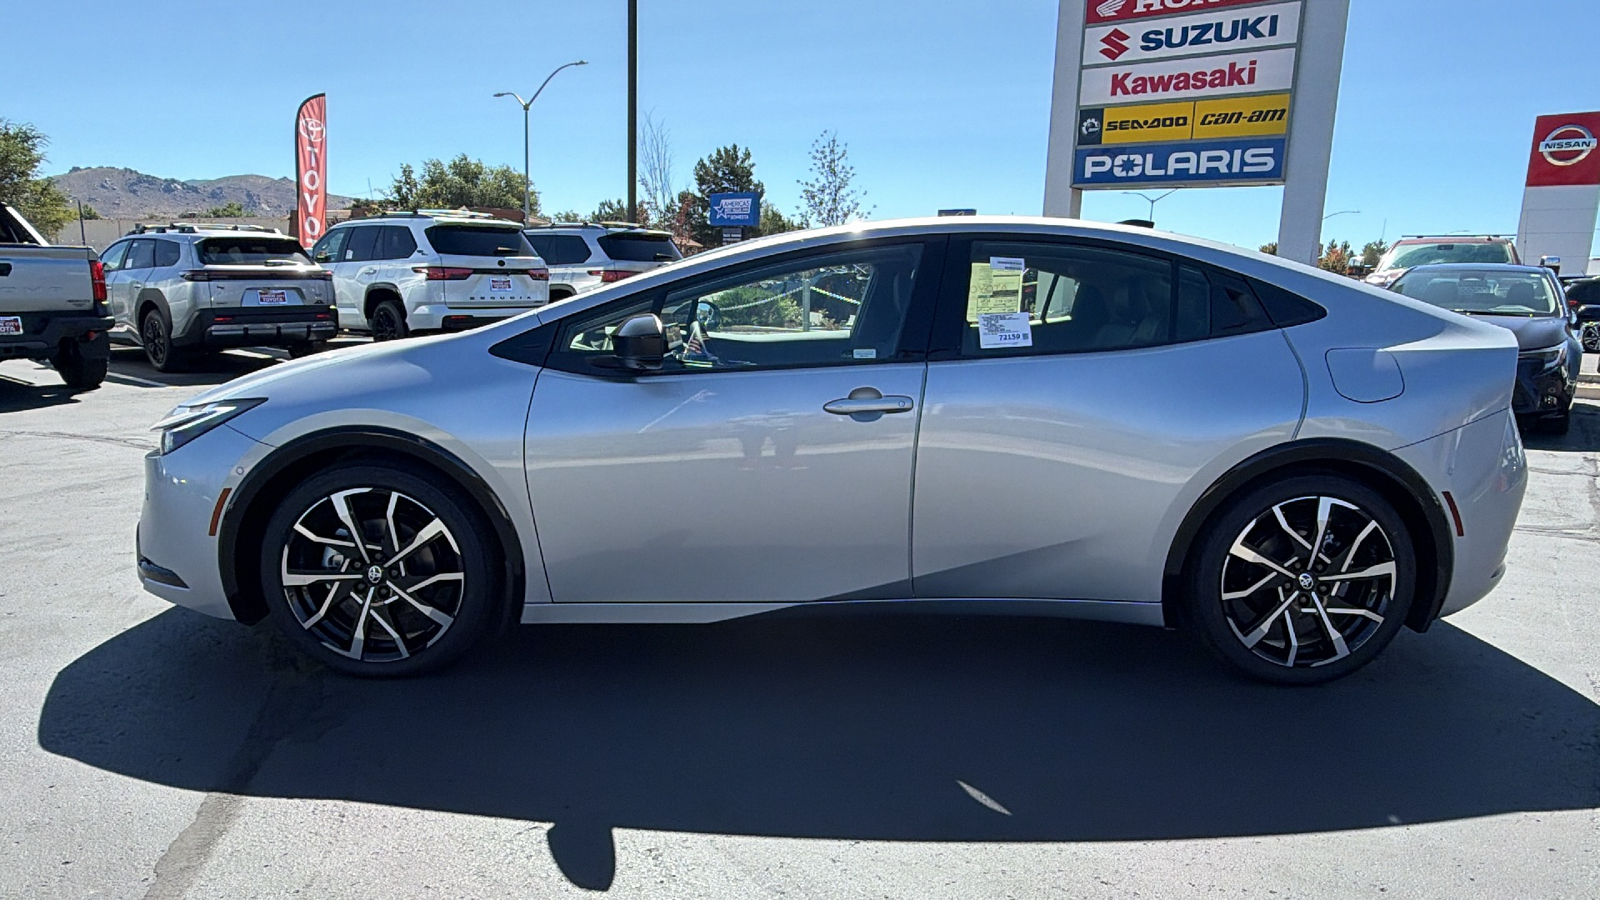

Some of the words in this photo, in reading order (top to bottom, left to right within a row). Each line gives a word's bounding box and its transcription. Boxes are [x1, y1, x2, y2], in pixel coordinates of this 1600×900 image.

[1140, 14, 1279, 51] SUZUKI
[1110, 60, 1257, 97] Kawasaki
[1200, 108, 1286, 126] can-am
[1544, 141, 1591, 150] NISSAN
[1084, 148, 1275, 178] POLARIS
